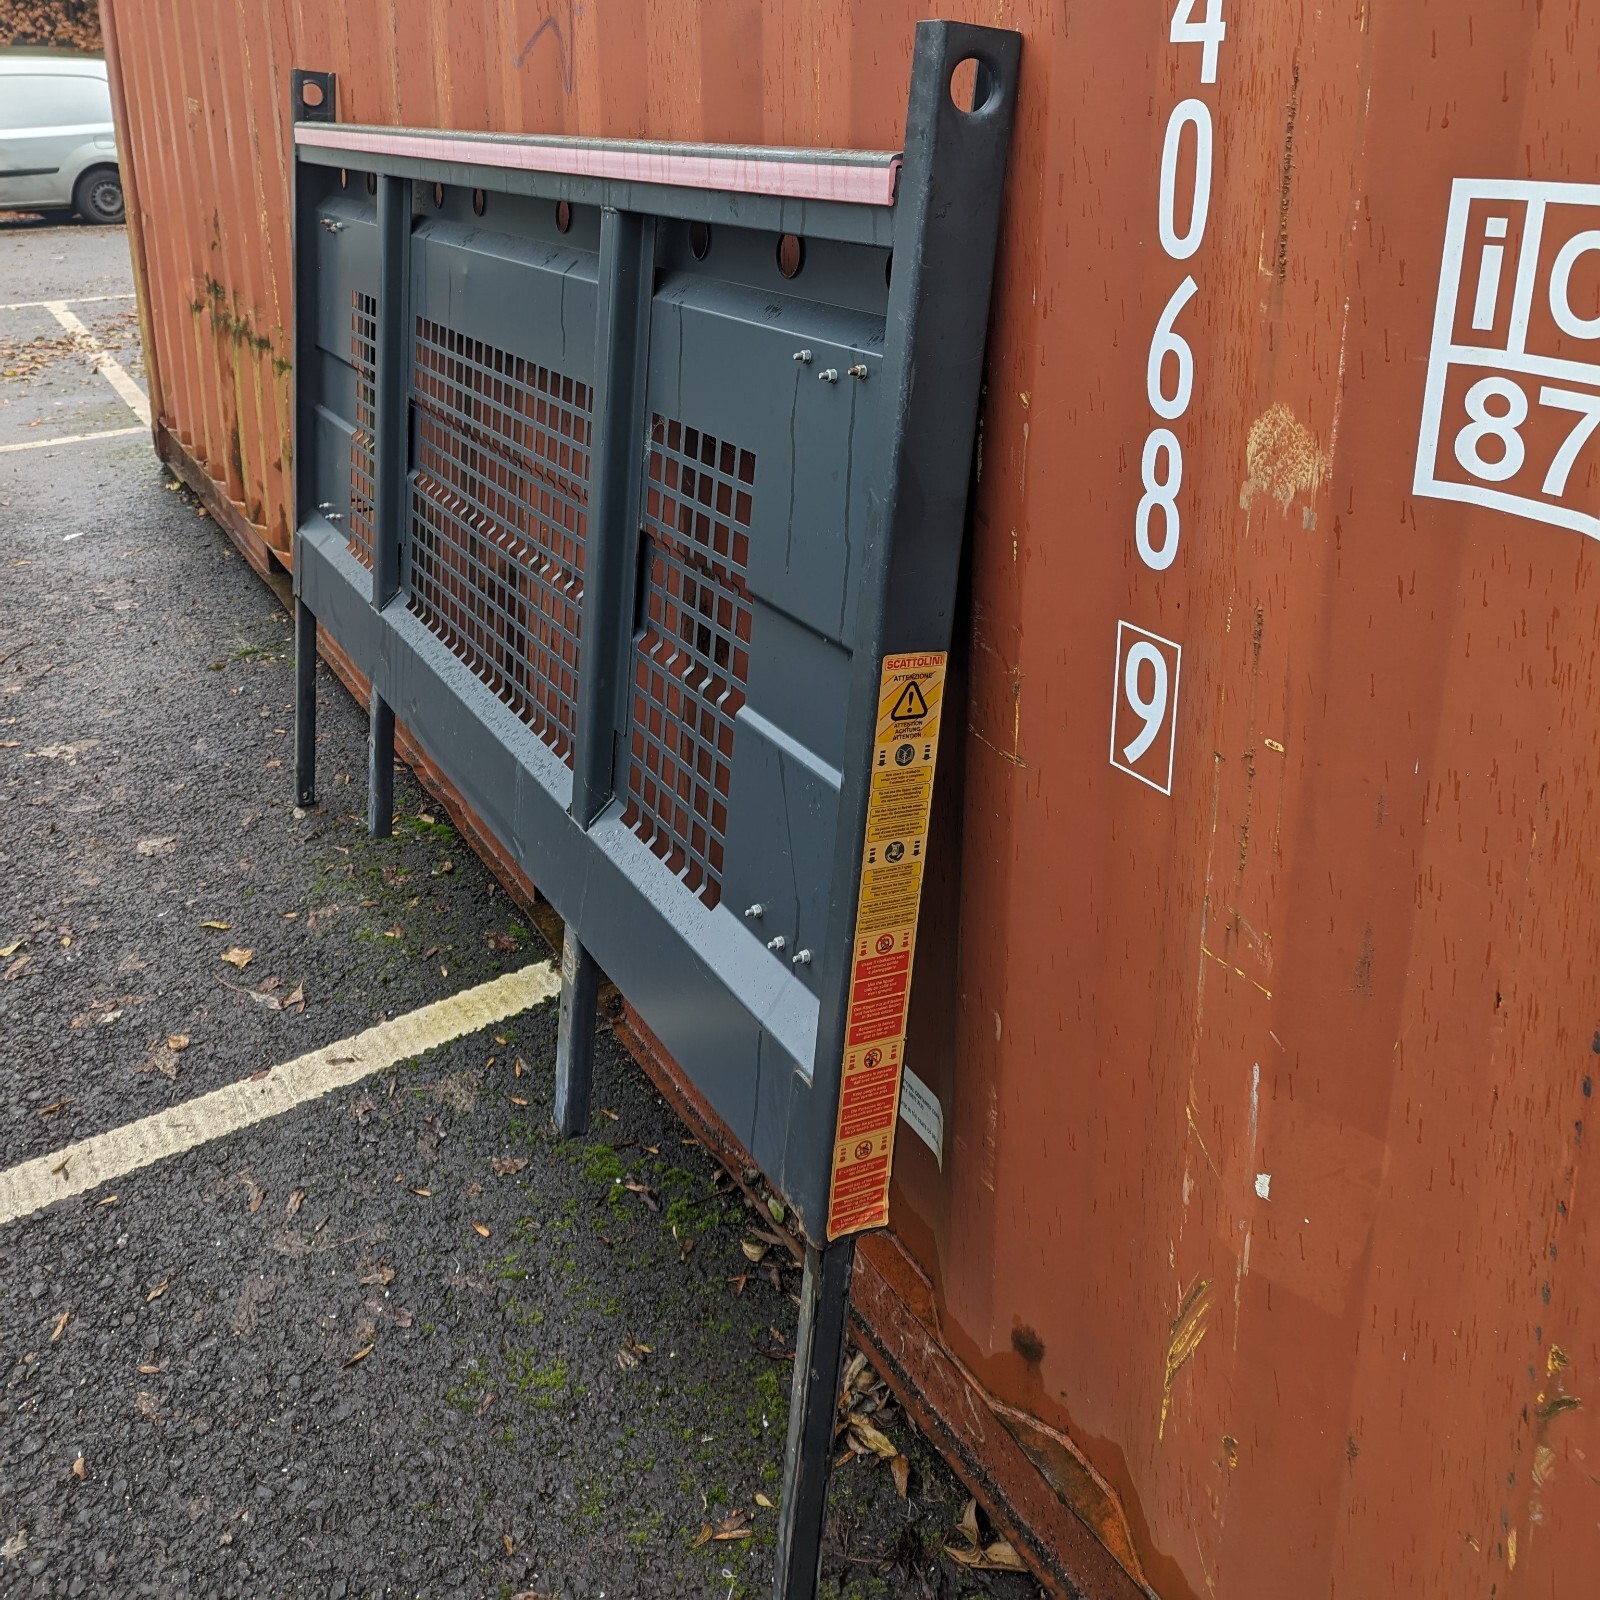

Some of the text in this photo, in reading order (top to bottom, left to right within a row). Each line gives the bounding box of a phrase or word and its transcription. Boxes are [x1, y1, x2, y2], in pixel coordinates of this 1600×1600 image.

[1454, 376, 1600, 498] 87
[886, 656, 943, 670] SCATTOLINI
[893, 672, 933, 682] ATTENZIONE
[1123, 641, 1168, 764] 9
[894, 720, 923, 728] ATTENTION
[894, 726, 921, 734] ACHTUNG
[892, 732, 922, 741] ATTENTION
